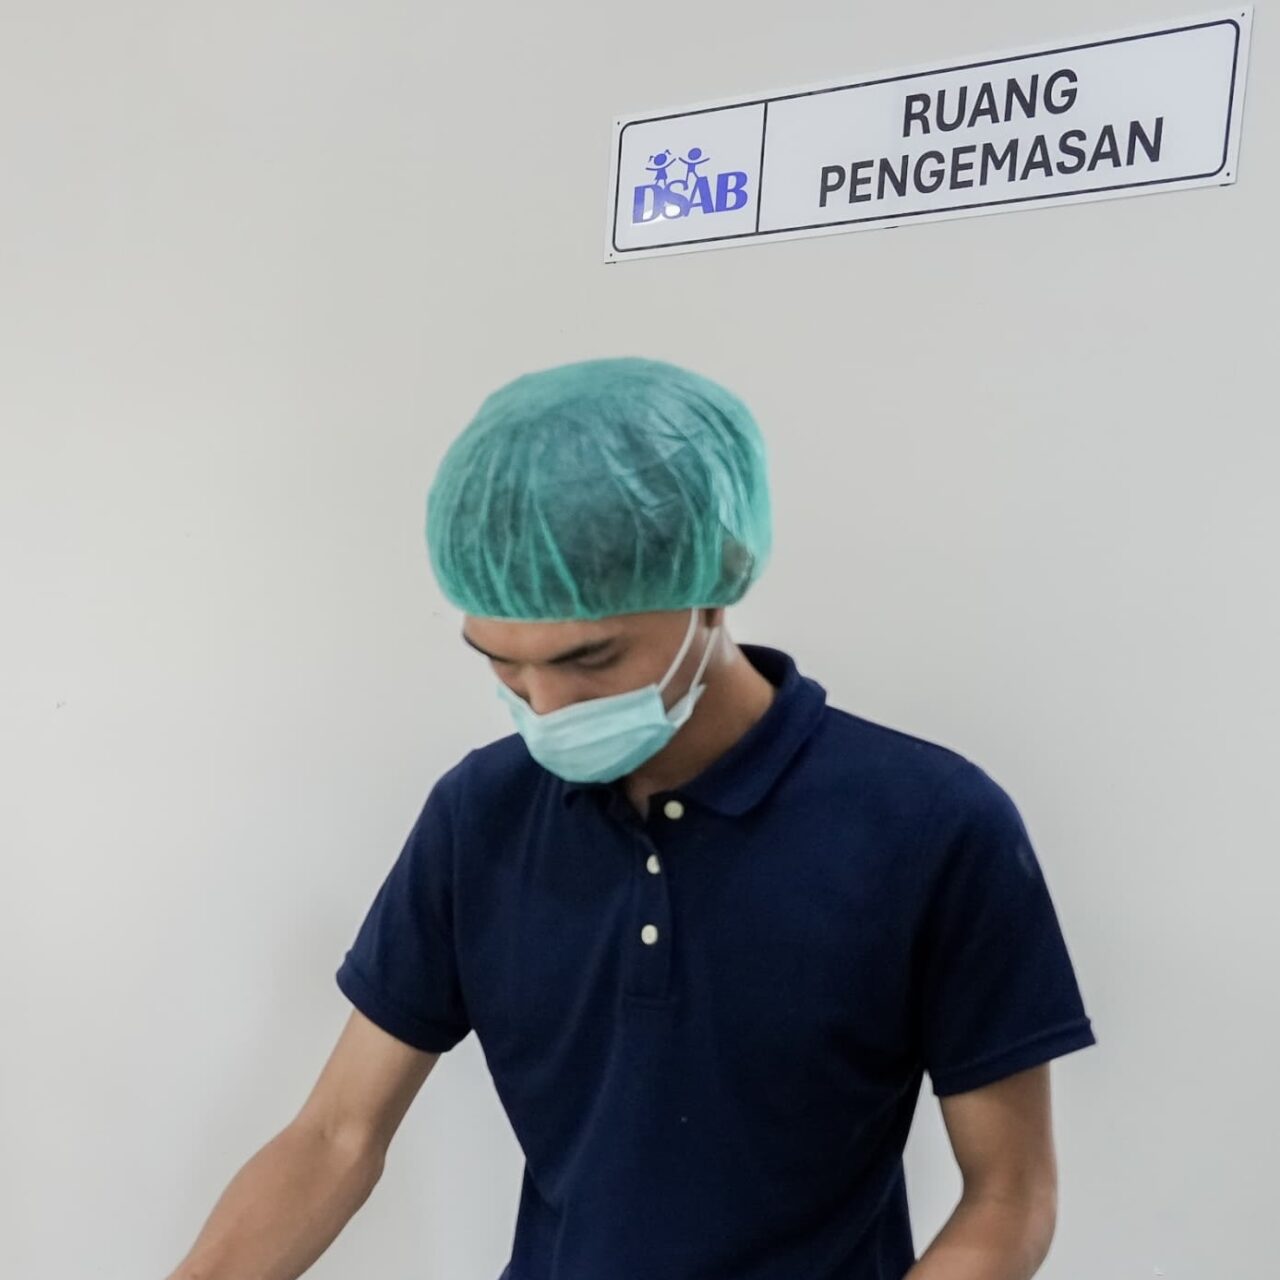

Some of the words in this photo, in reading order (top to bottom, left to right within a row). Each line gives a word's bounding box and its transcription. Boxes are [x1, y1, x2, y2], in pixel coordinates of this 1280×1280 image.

[902, 69, 1078, 137] RUANG
[819, 116, 1164, 207] PENGEMASAN
[632, 171, 748, 224] DSAB
